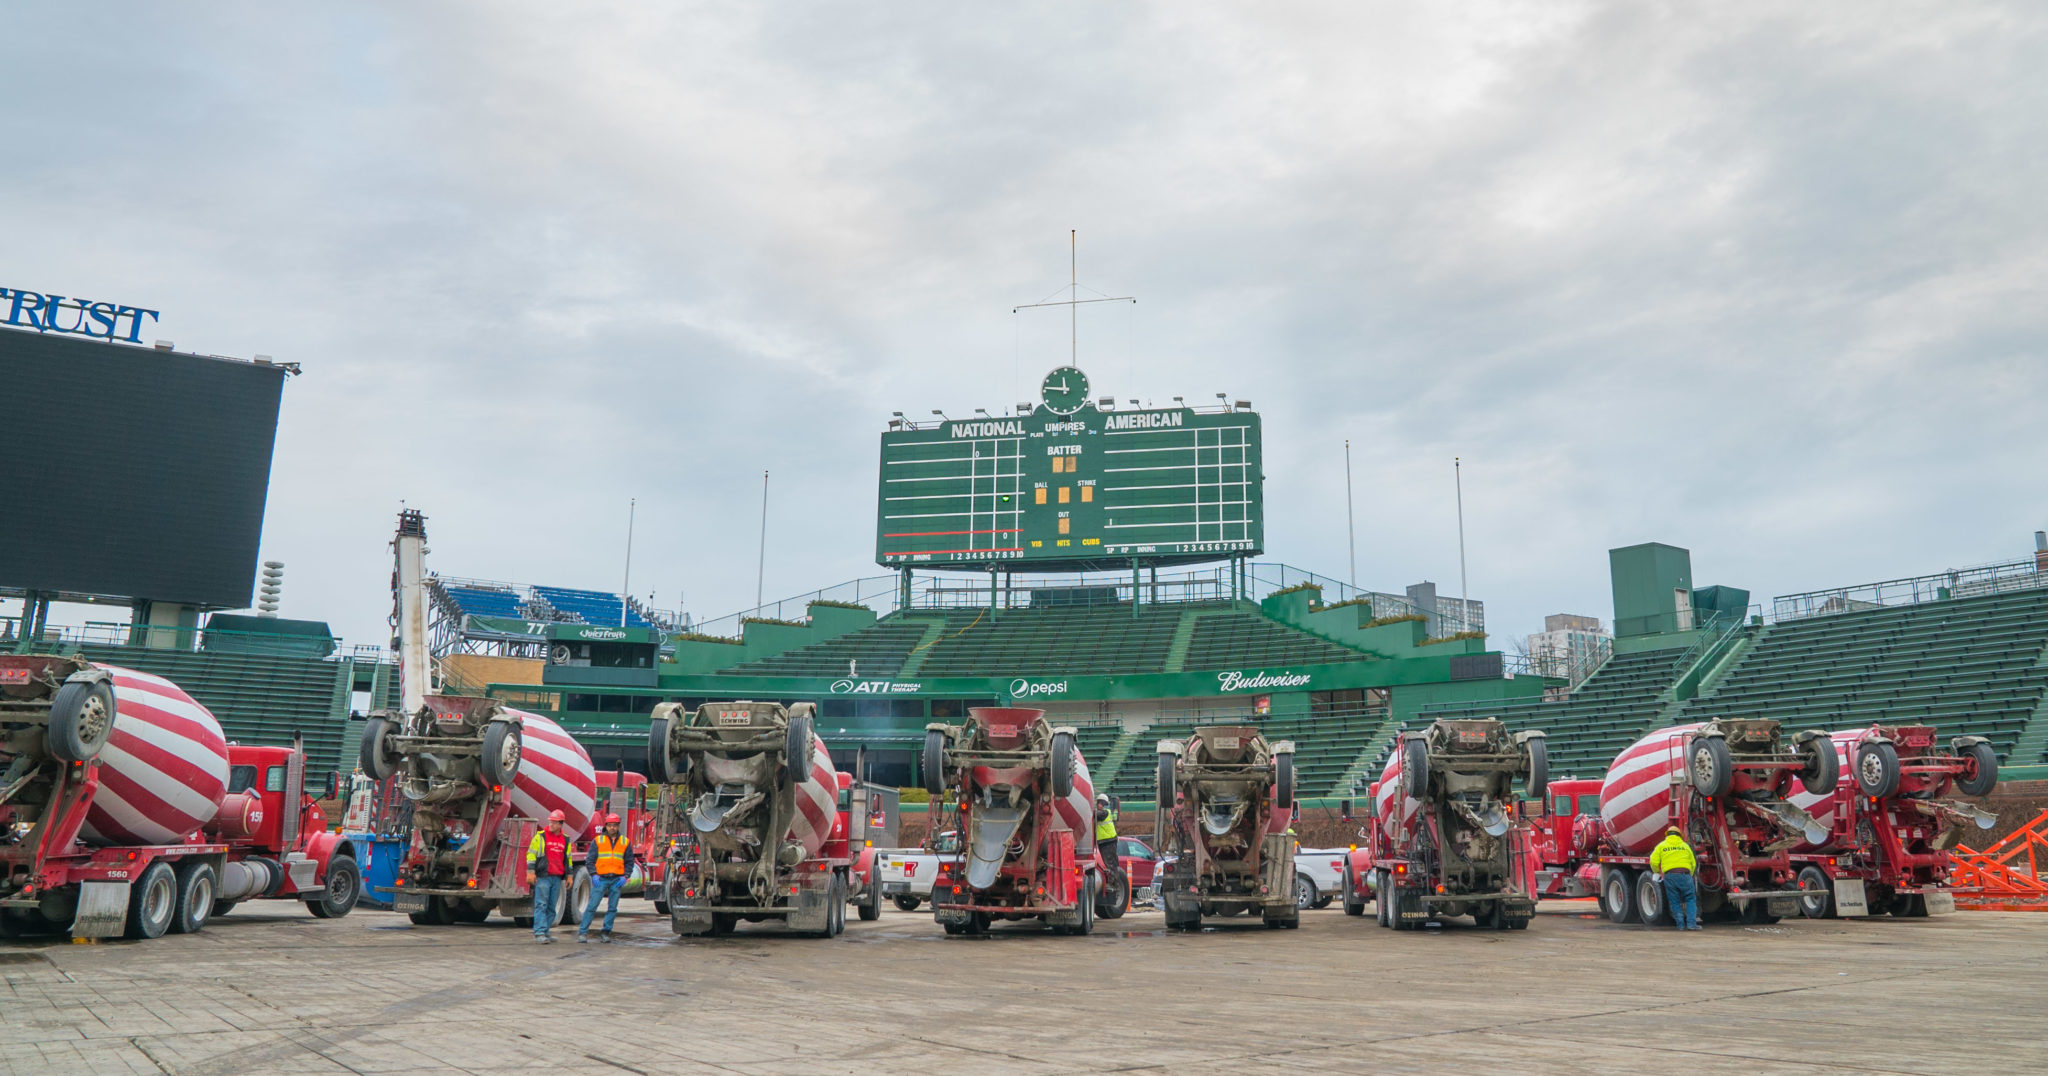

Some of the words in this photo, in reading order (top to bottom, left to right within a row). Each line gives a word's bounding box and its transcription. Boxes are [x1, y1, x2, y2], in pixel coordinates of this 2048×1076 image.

[1045, 421, 1085, 432] UMPIRES
[1104, 412, 1182, 430] AMERICAN
[952, 421, 1026, 438] NATIONAL
[1047, 445, 1082, 456] BATTER
[527, 622, 548, 634] 77
[580, 630, 602, 638] Juicy
[604, 631, 626, 639] Fruit
[1217, 670, 1310, 692] Budweiser
[853, 682, 890, 693] ATI
[1030, 680, 1068, 696] pepsi
